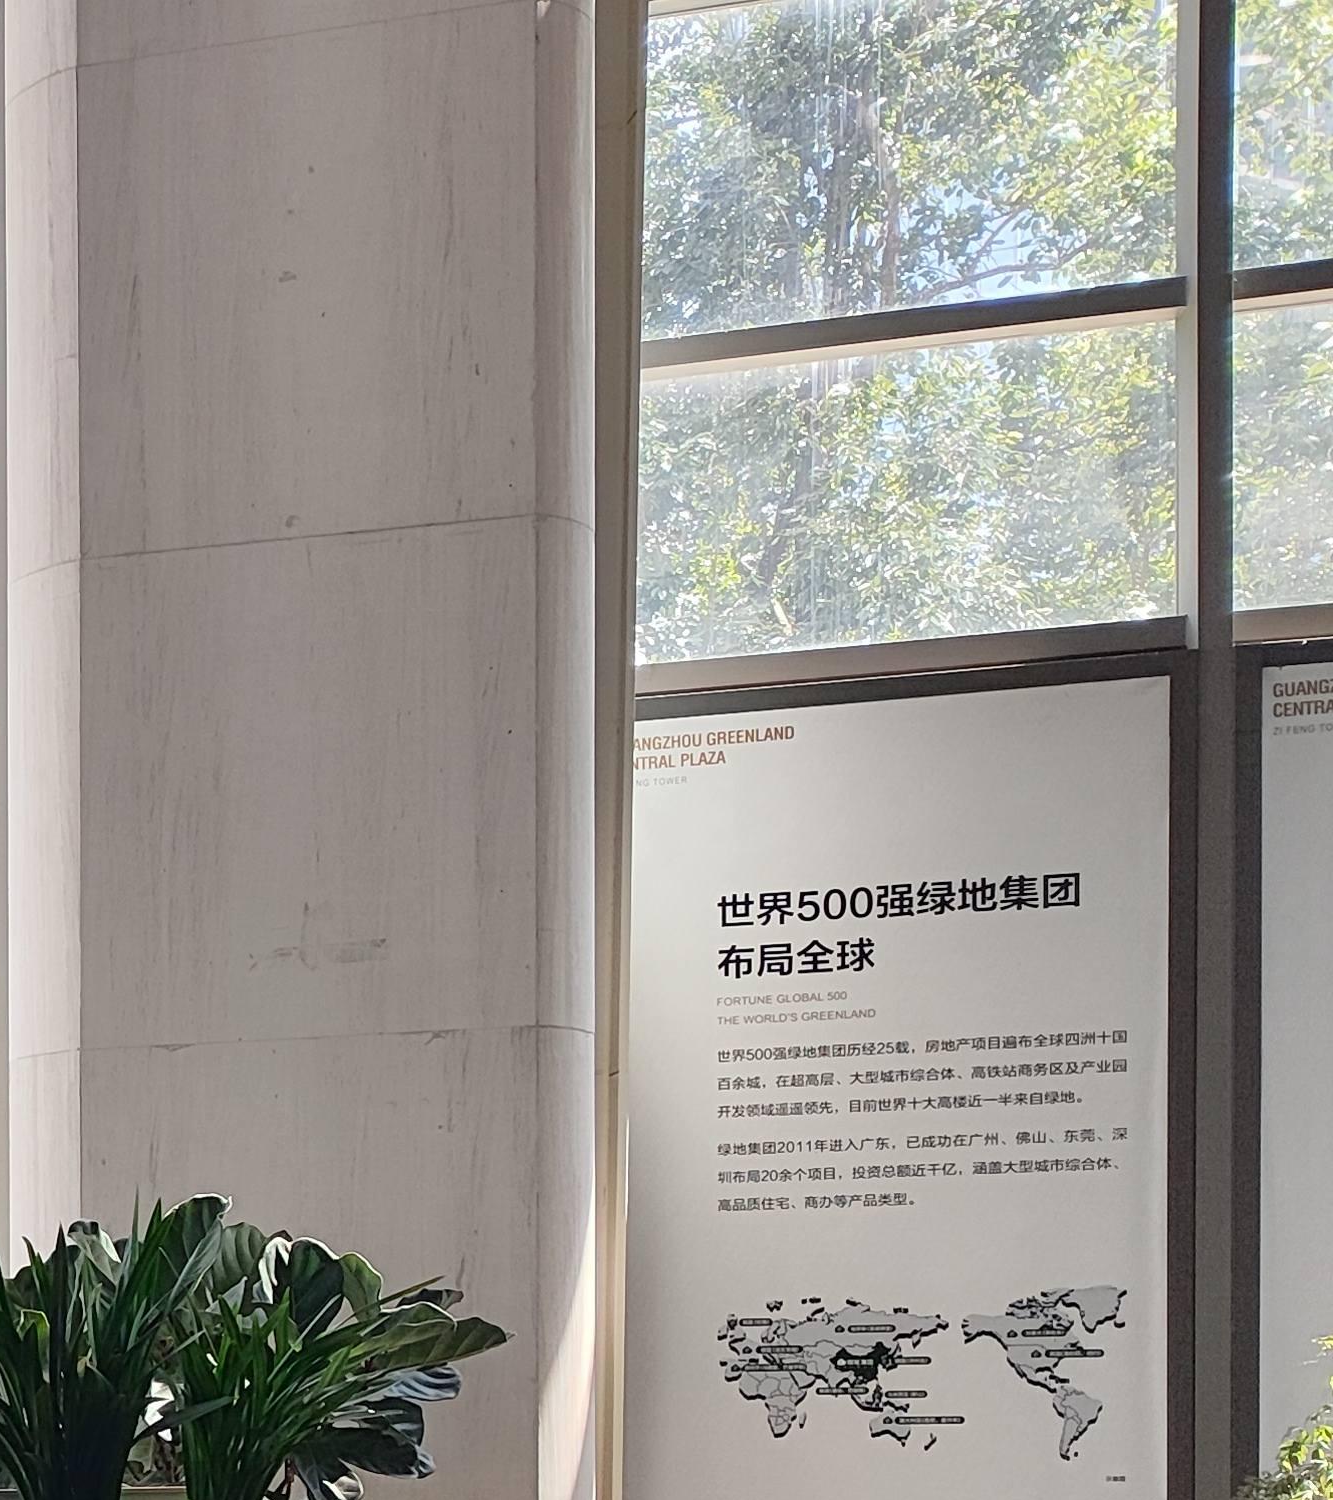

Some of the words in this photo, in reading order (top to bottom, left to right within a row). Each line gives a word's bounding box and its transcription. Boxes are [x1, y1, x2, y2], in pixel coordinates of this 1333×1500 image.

[1273, 679, 1333, 698] GUANG
[707, 726, 795, 746] GREENLAND
[681, 750, 726, 767] PLAZA
[717, 872, 1080, 928] 世界500强绿地集团
[718, 937, 875, 979] 布局全球
[717, 995, 773, 1006] FORTUNE
[776, 992, 824, 1004] GLOBAL
[827, 991, 847, 1001] 500
[717, 1015, 740, 1025] THE
[743, 1012, 798, 1025] WORLD'S
[801, 1008, 876, 1022] GREENLAND
